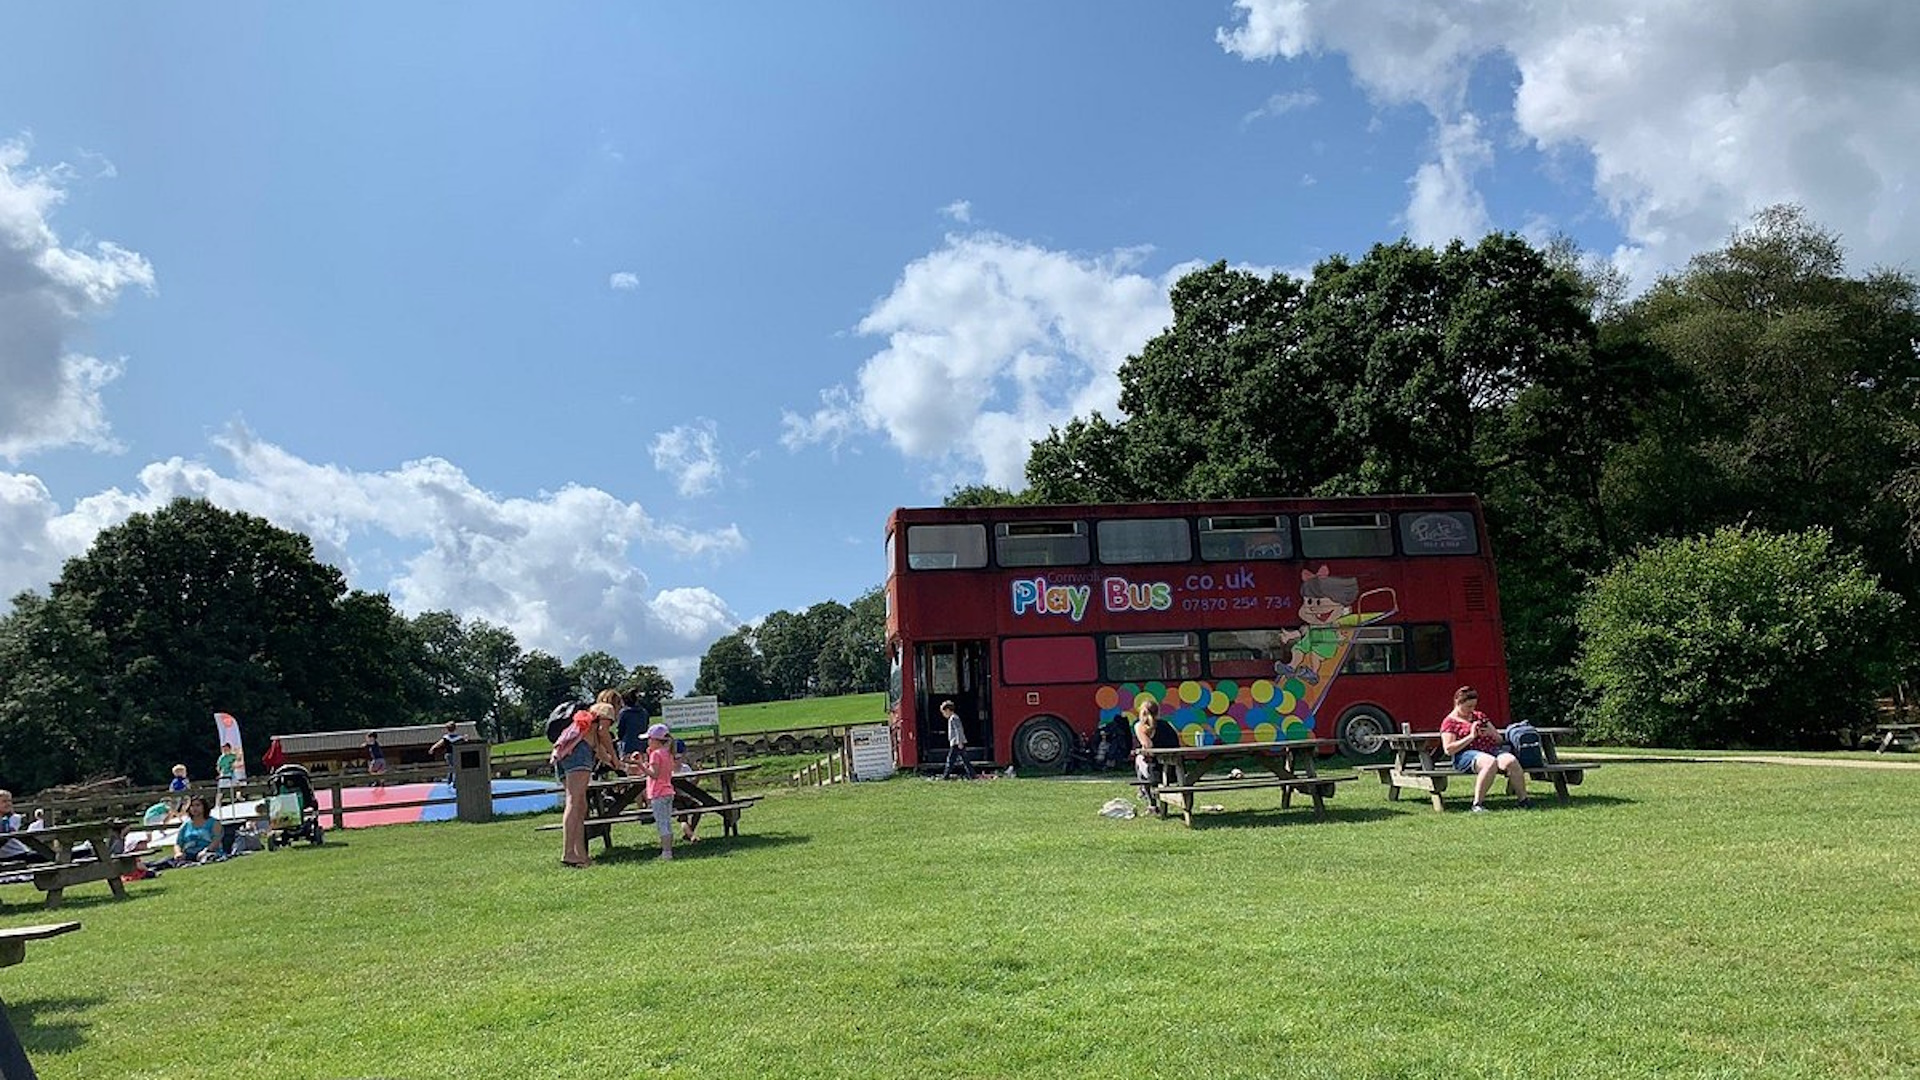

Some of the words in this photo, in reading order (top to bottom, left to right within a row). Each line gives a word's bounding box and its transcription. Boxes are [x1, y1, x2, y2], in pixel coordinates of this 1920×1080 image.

[1013, 577, 1090, 621] Play
[1105, 577, 1172, 611] Bus
[1182, 597, 1228, 611] 07870
[1232, 596, 1259, 610] 254
[1264, 595, 1292, 610] 734
